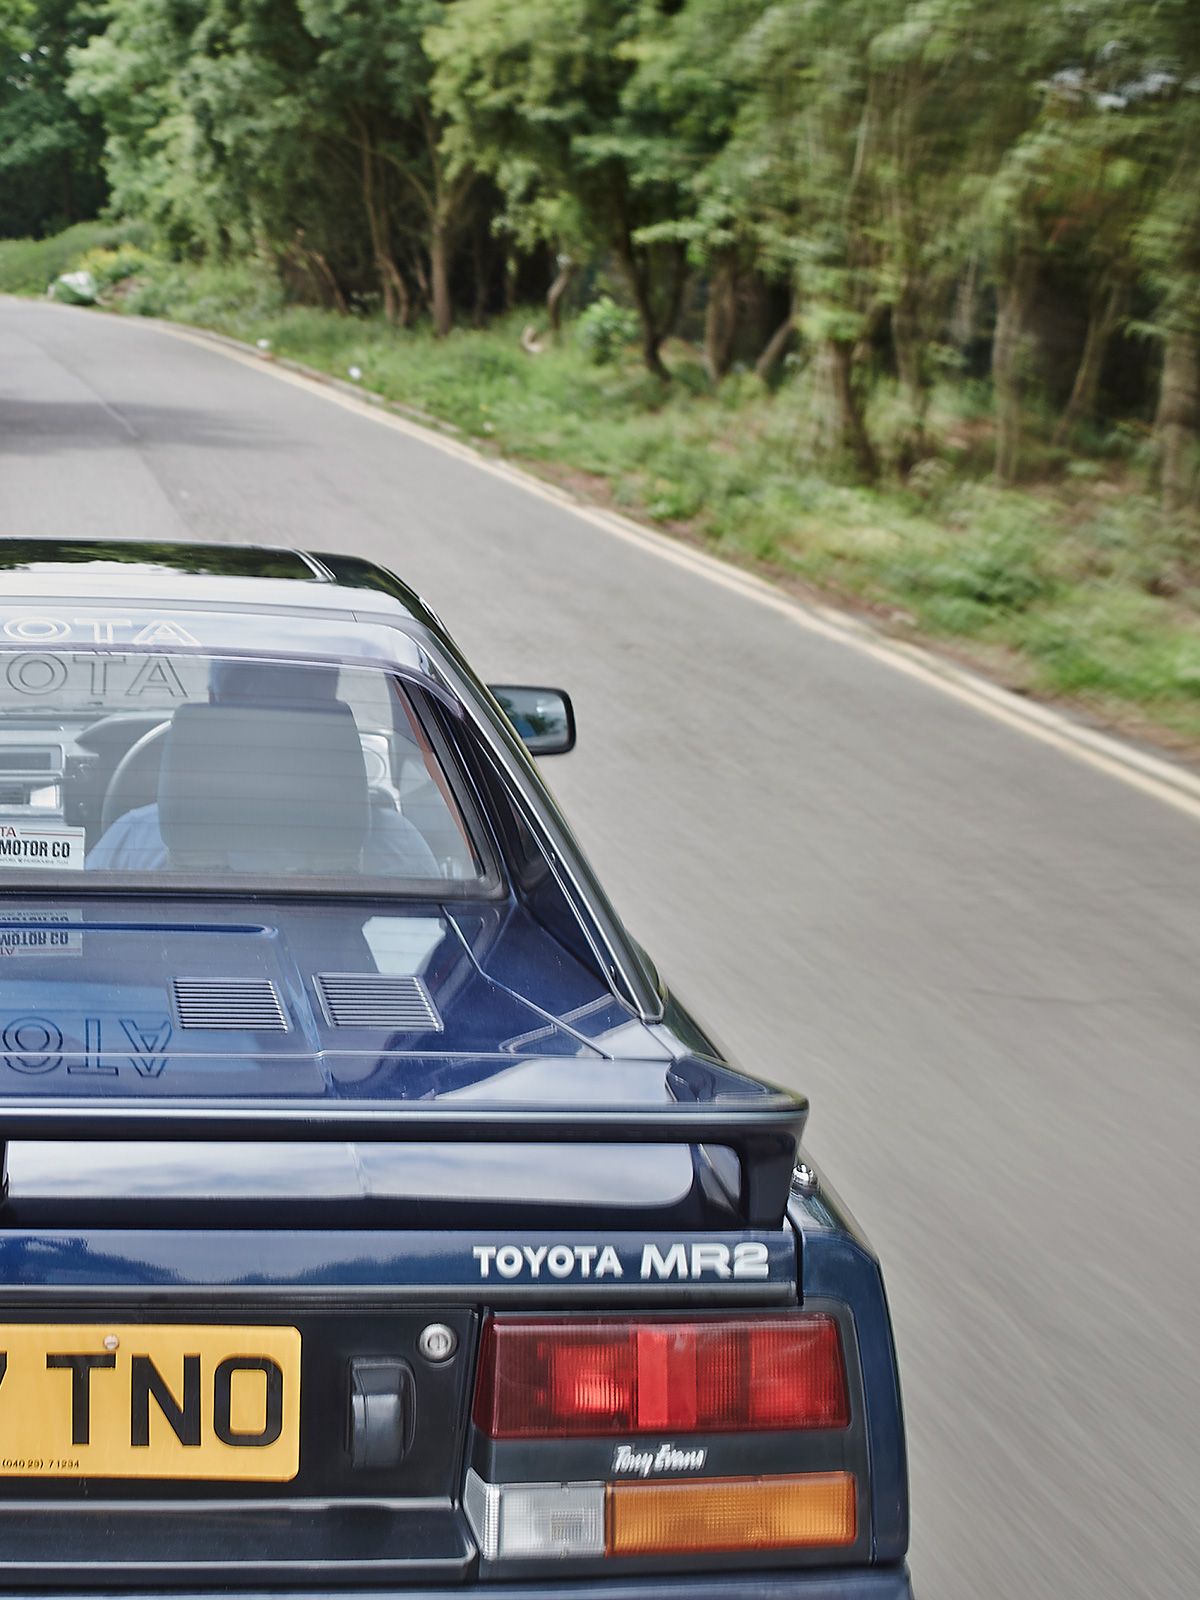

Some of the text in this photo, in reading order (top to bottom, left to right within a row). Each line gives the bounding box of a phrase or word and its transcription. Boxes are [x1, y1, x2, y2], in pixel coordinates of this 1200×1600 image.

[52, 841, 70, 858] CO
[473, 1242, 770, 1280] TOYOTA MR2
[46, 1351, 283, 1448] TNO
[614, 1445, 704, 1477] Tony Evans
